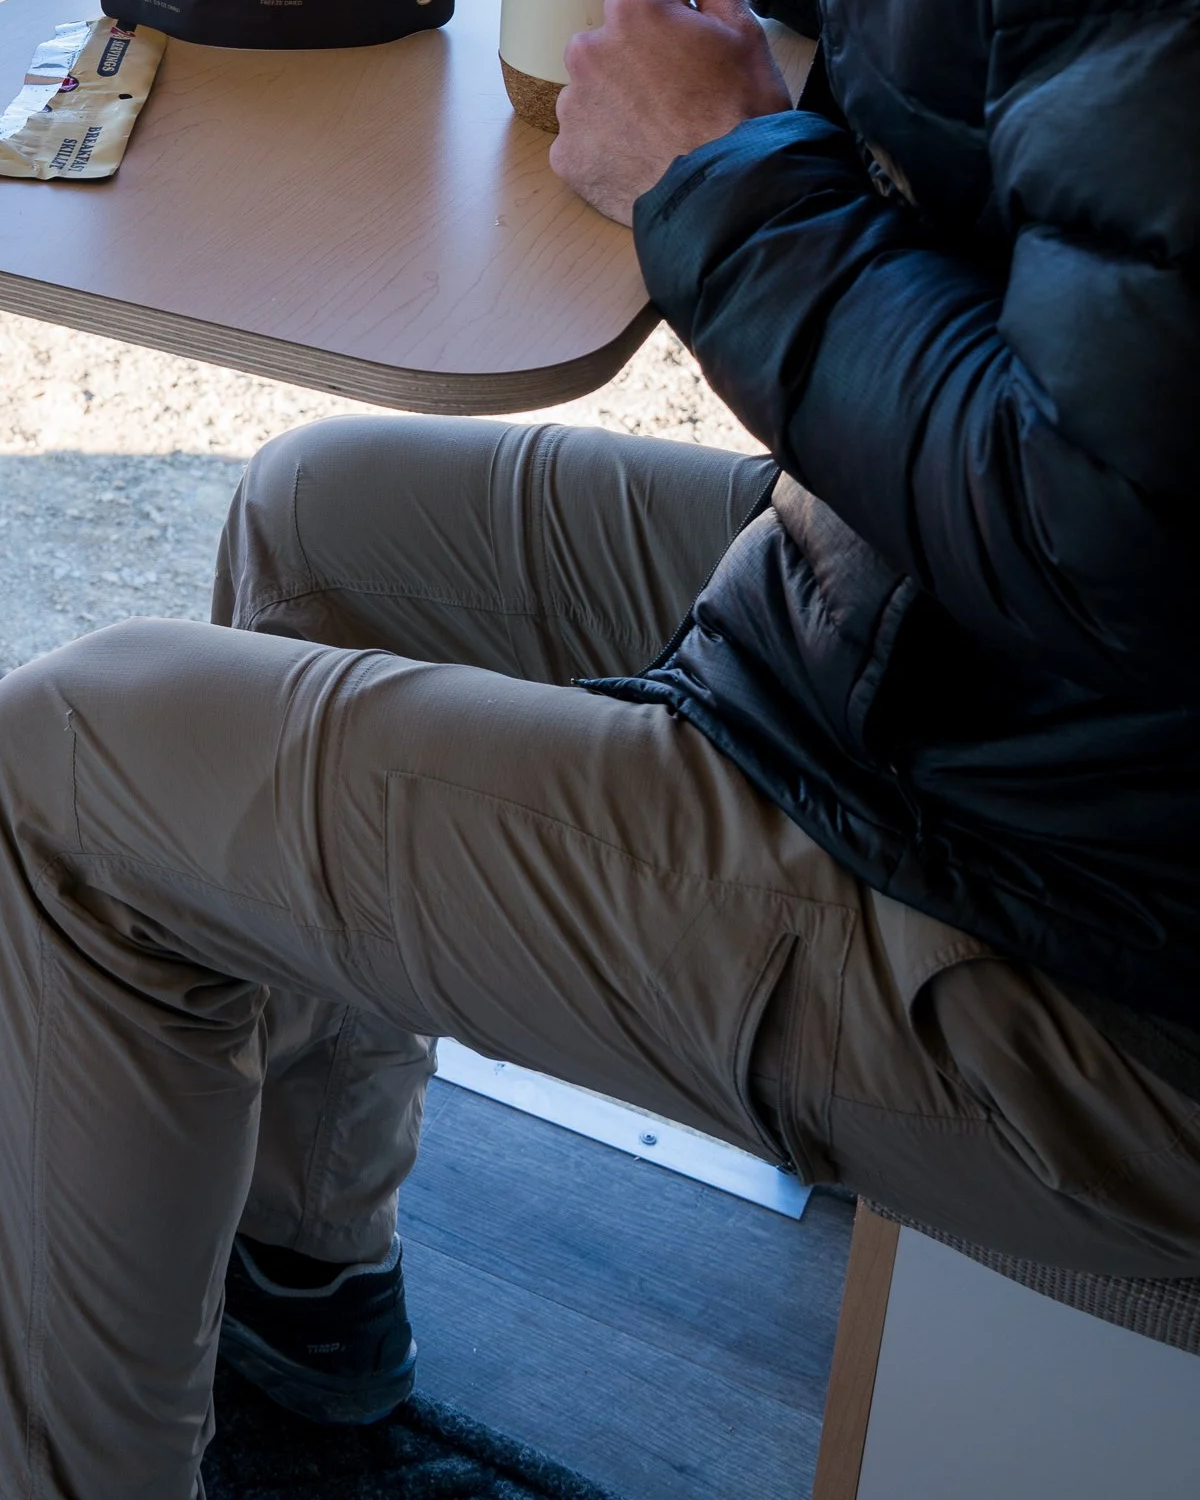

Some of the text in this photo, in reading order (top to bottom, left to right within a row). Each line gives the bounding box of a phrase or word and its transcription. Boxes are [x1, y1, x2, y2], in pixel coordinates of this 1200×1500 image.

[102, 39, 126, 71] SERVINGS
[49, 138, 77, 170] SKILLET
[68, 126, 103, 172] BREAKFAST
